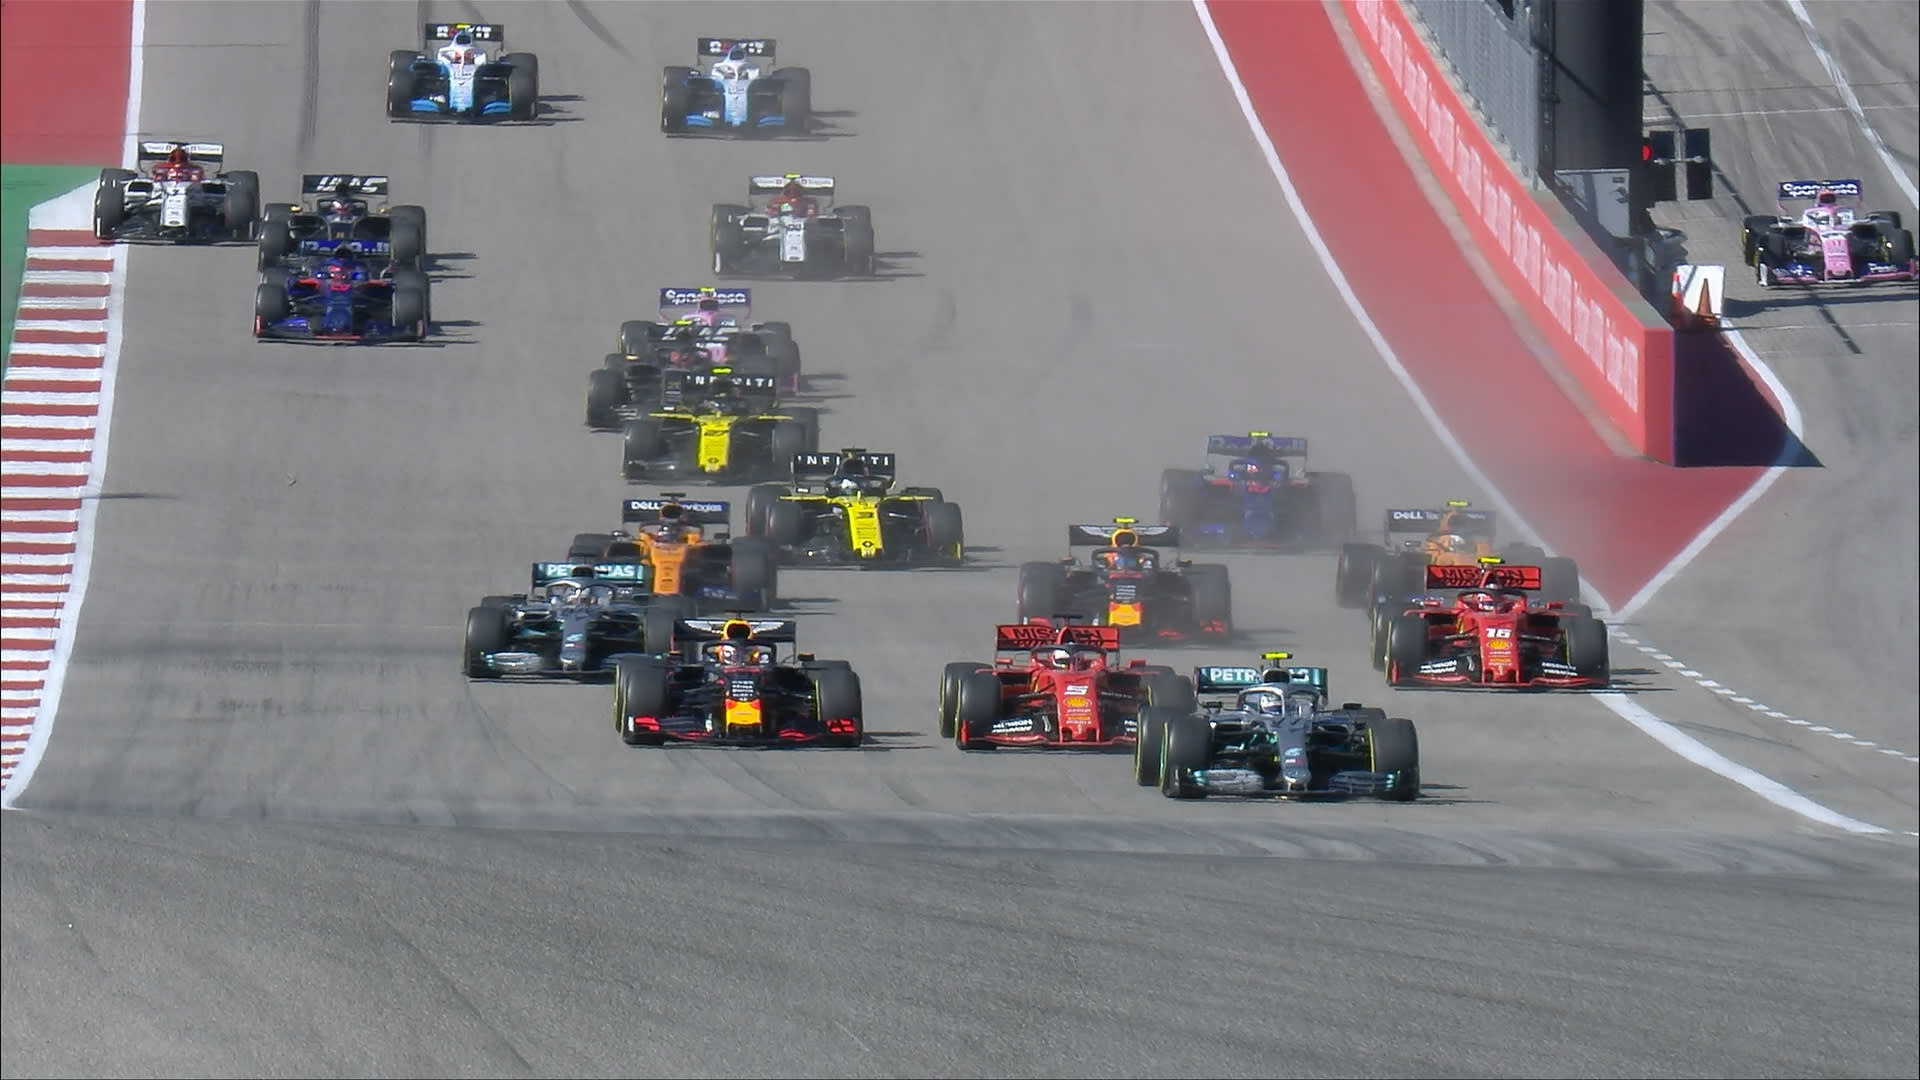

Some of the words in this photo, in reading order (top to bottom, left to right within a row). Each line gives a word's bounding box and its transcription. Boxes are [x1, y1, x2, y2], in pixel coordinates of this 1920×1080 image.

[797, 455, 889, 466] INFITI
[546, 563, 635, 578] PEAS
[1442, 568, 1525, 580] MISSON
[1486, 628, 1512, 638] 16
[1210, 668, 1310, 682] PETRS
